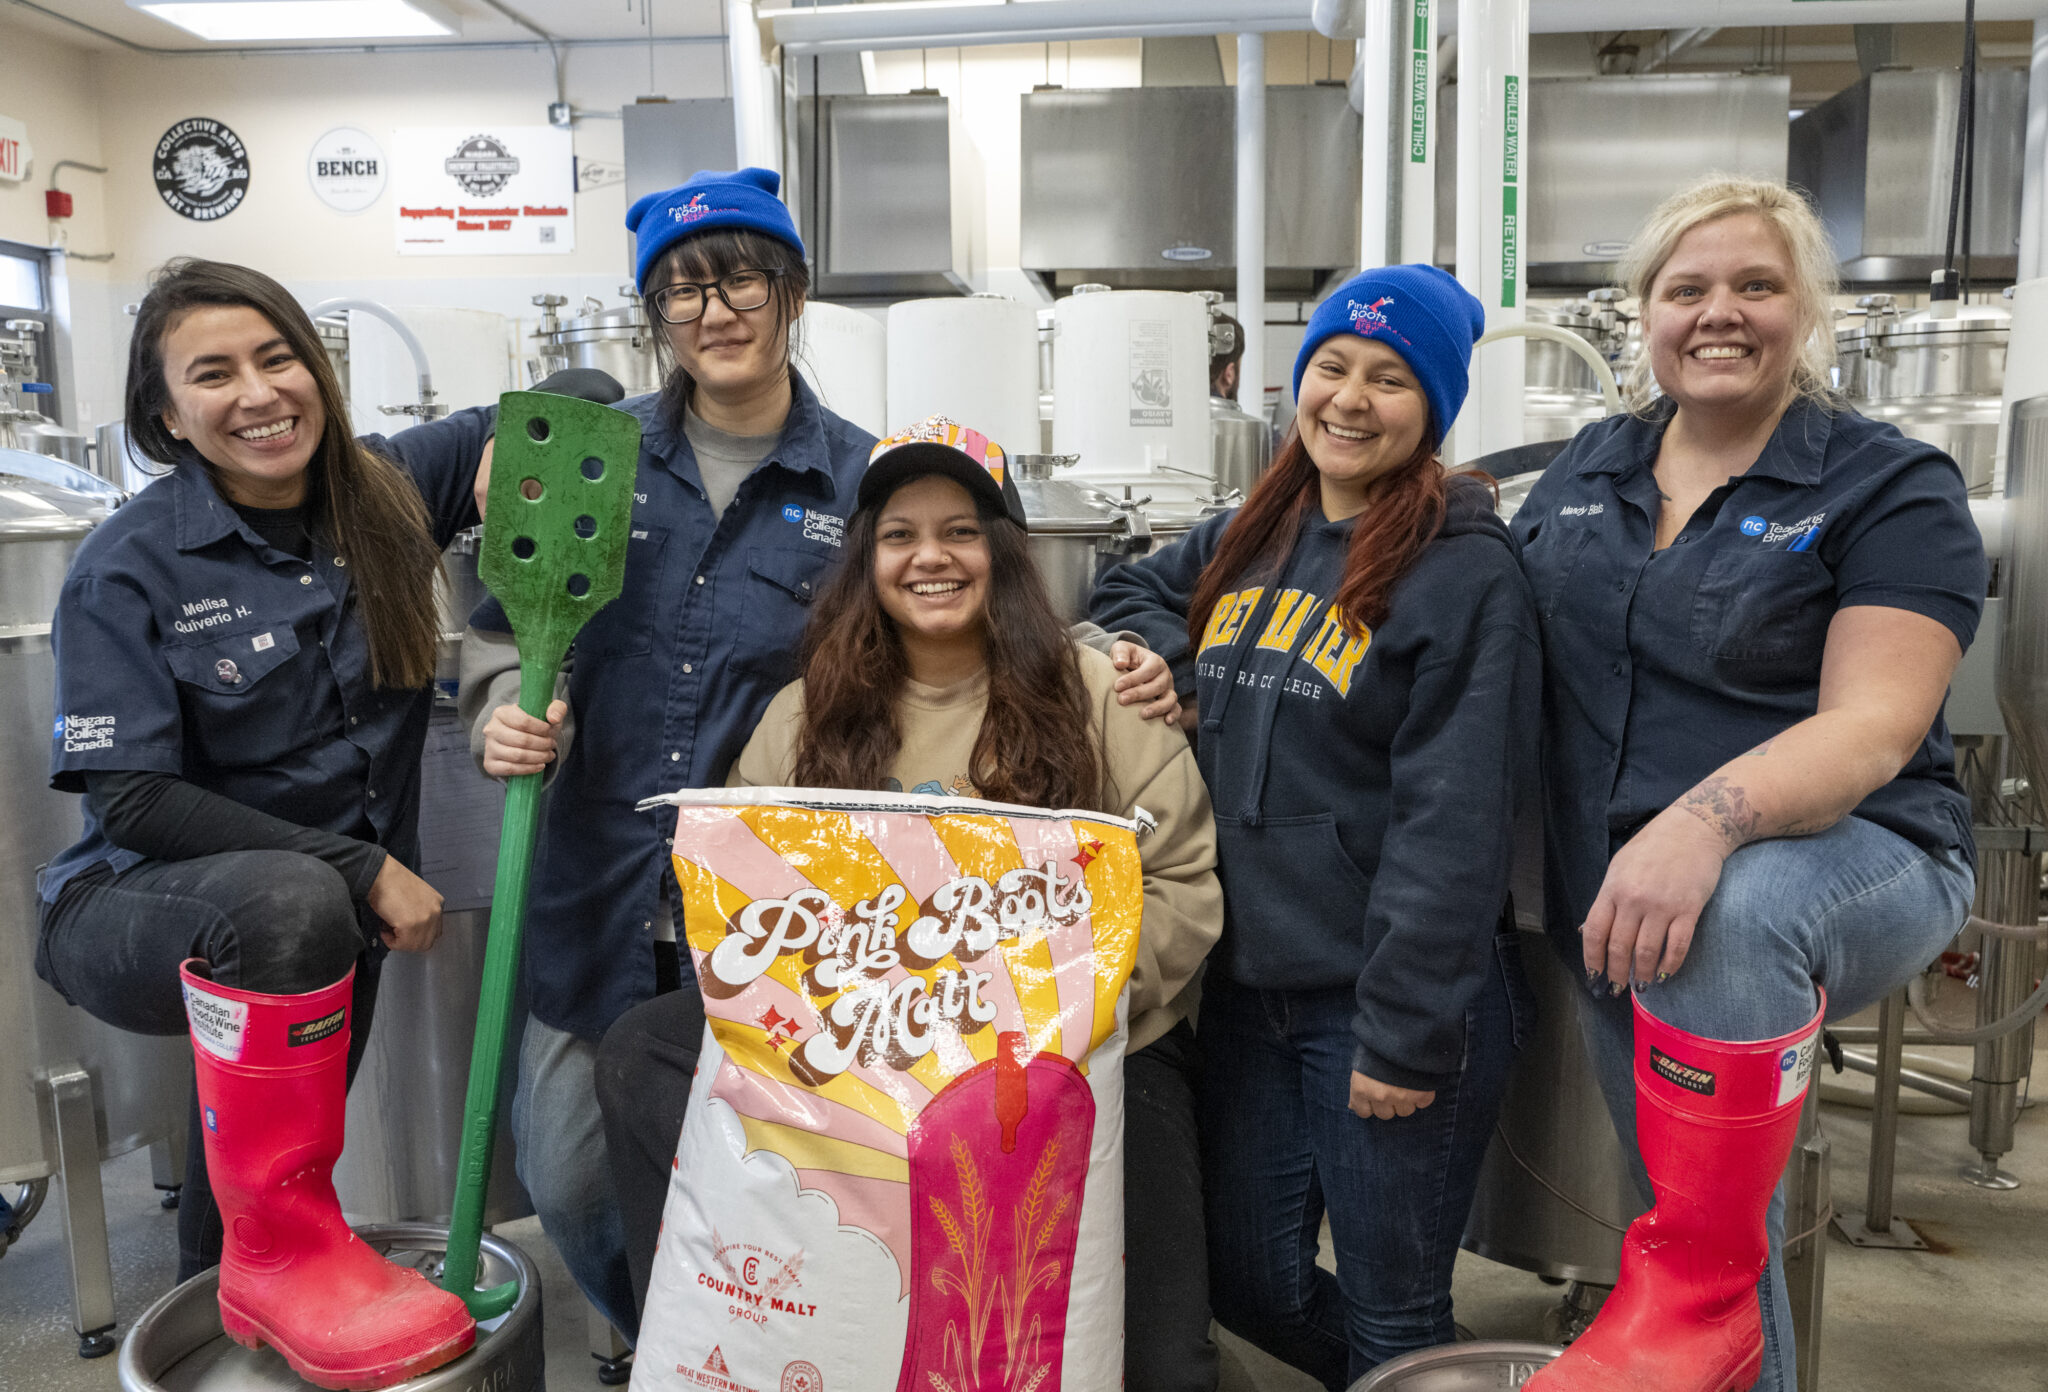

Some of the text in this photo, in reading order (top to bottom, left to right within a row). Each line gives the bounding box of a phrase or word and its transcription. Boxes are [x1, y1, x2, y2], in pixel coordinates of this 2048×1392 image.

[1412, 59, 1426, 156] CHILLED WATER
[157, 121, 218, 159] COLLECTIVE
[220, 129, 244, 159] ARTS
[1504, 82, 1518, 177] CHILLED WATER
[0, 137, 19, 176] XIT
[317, 160, 378, 176] BENCH
[163, 190, 184, 211] ART
[193, 188, 243, 219] BREWING
[1503, 215, 1515, 280] RETURN
[1347, 299, 1370, 311] Pink
[1349, 309, 1387, 324] Boots
[633, 493, 647, 503] ng
[785, 508, 844, 526] nc Niagara
[804, 519, 843, 536] College
[1743, 520, 1763, 531] nc
[803, 528, 841, 547] Canada
[182, 598, 229, 616] Melisa
[174, 612, 232, 633] Quiverio
[1199, 663, 1323, 699] NIAGRA CLEGE
[65, 715, 116, 729] Niagara
[65, 727, 115, 739] College
[65, 738, 114, 752] Canada
[903, 861, 1093, 965] Boots
[704, 884, 906, 995] Pink
[190, 992, 230, 1018] Canadian
[193, 1014, 223, 1040] Institute
[303, 1008, 345, 1035] BAFFIN
[798, 969, 998, 1080] Malt
[301, 1025, 340, 1043] TECHNOLOGY
[1658, 1056, 1713, 1085] BAFFIN
[1783, 1055, 1795, 1067] nc
[1657, 1065, 1703, 1091] TECHNOLOGY
[743, 1244, 762, 1253] YOUR
[697, 1272, 817, 1317] COUNTRY MALT
[728, 1304, 768, 1324] GROUP
[676, 1363, 695, 1378] GREAT
[696, 1371, 728, 1389] WESTERN
